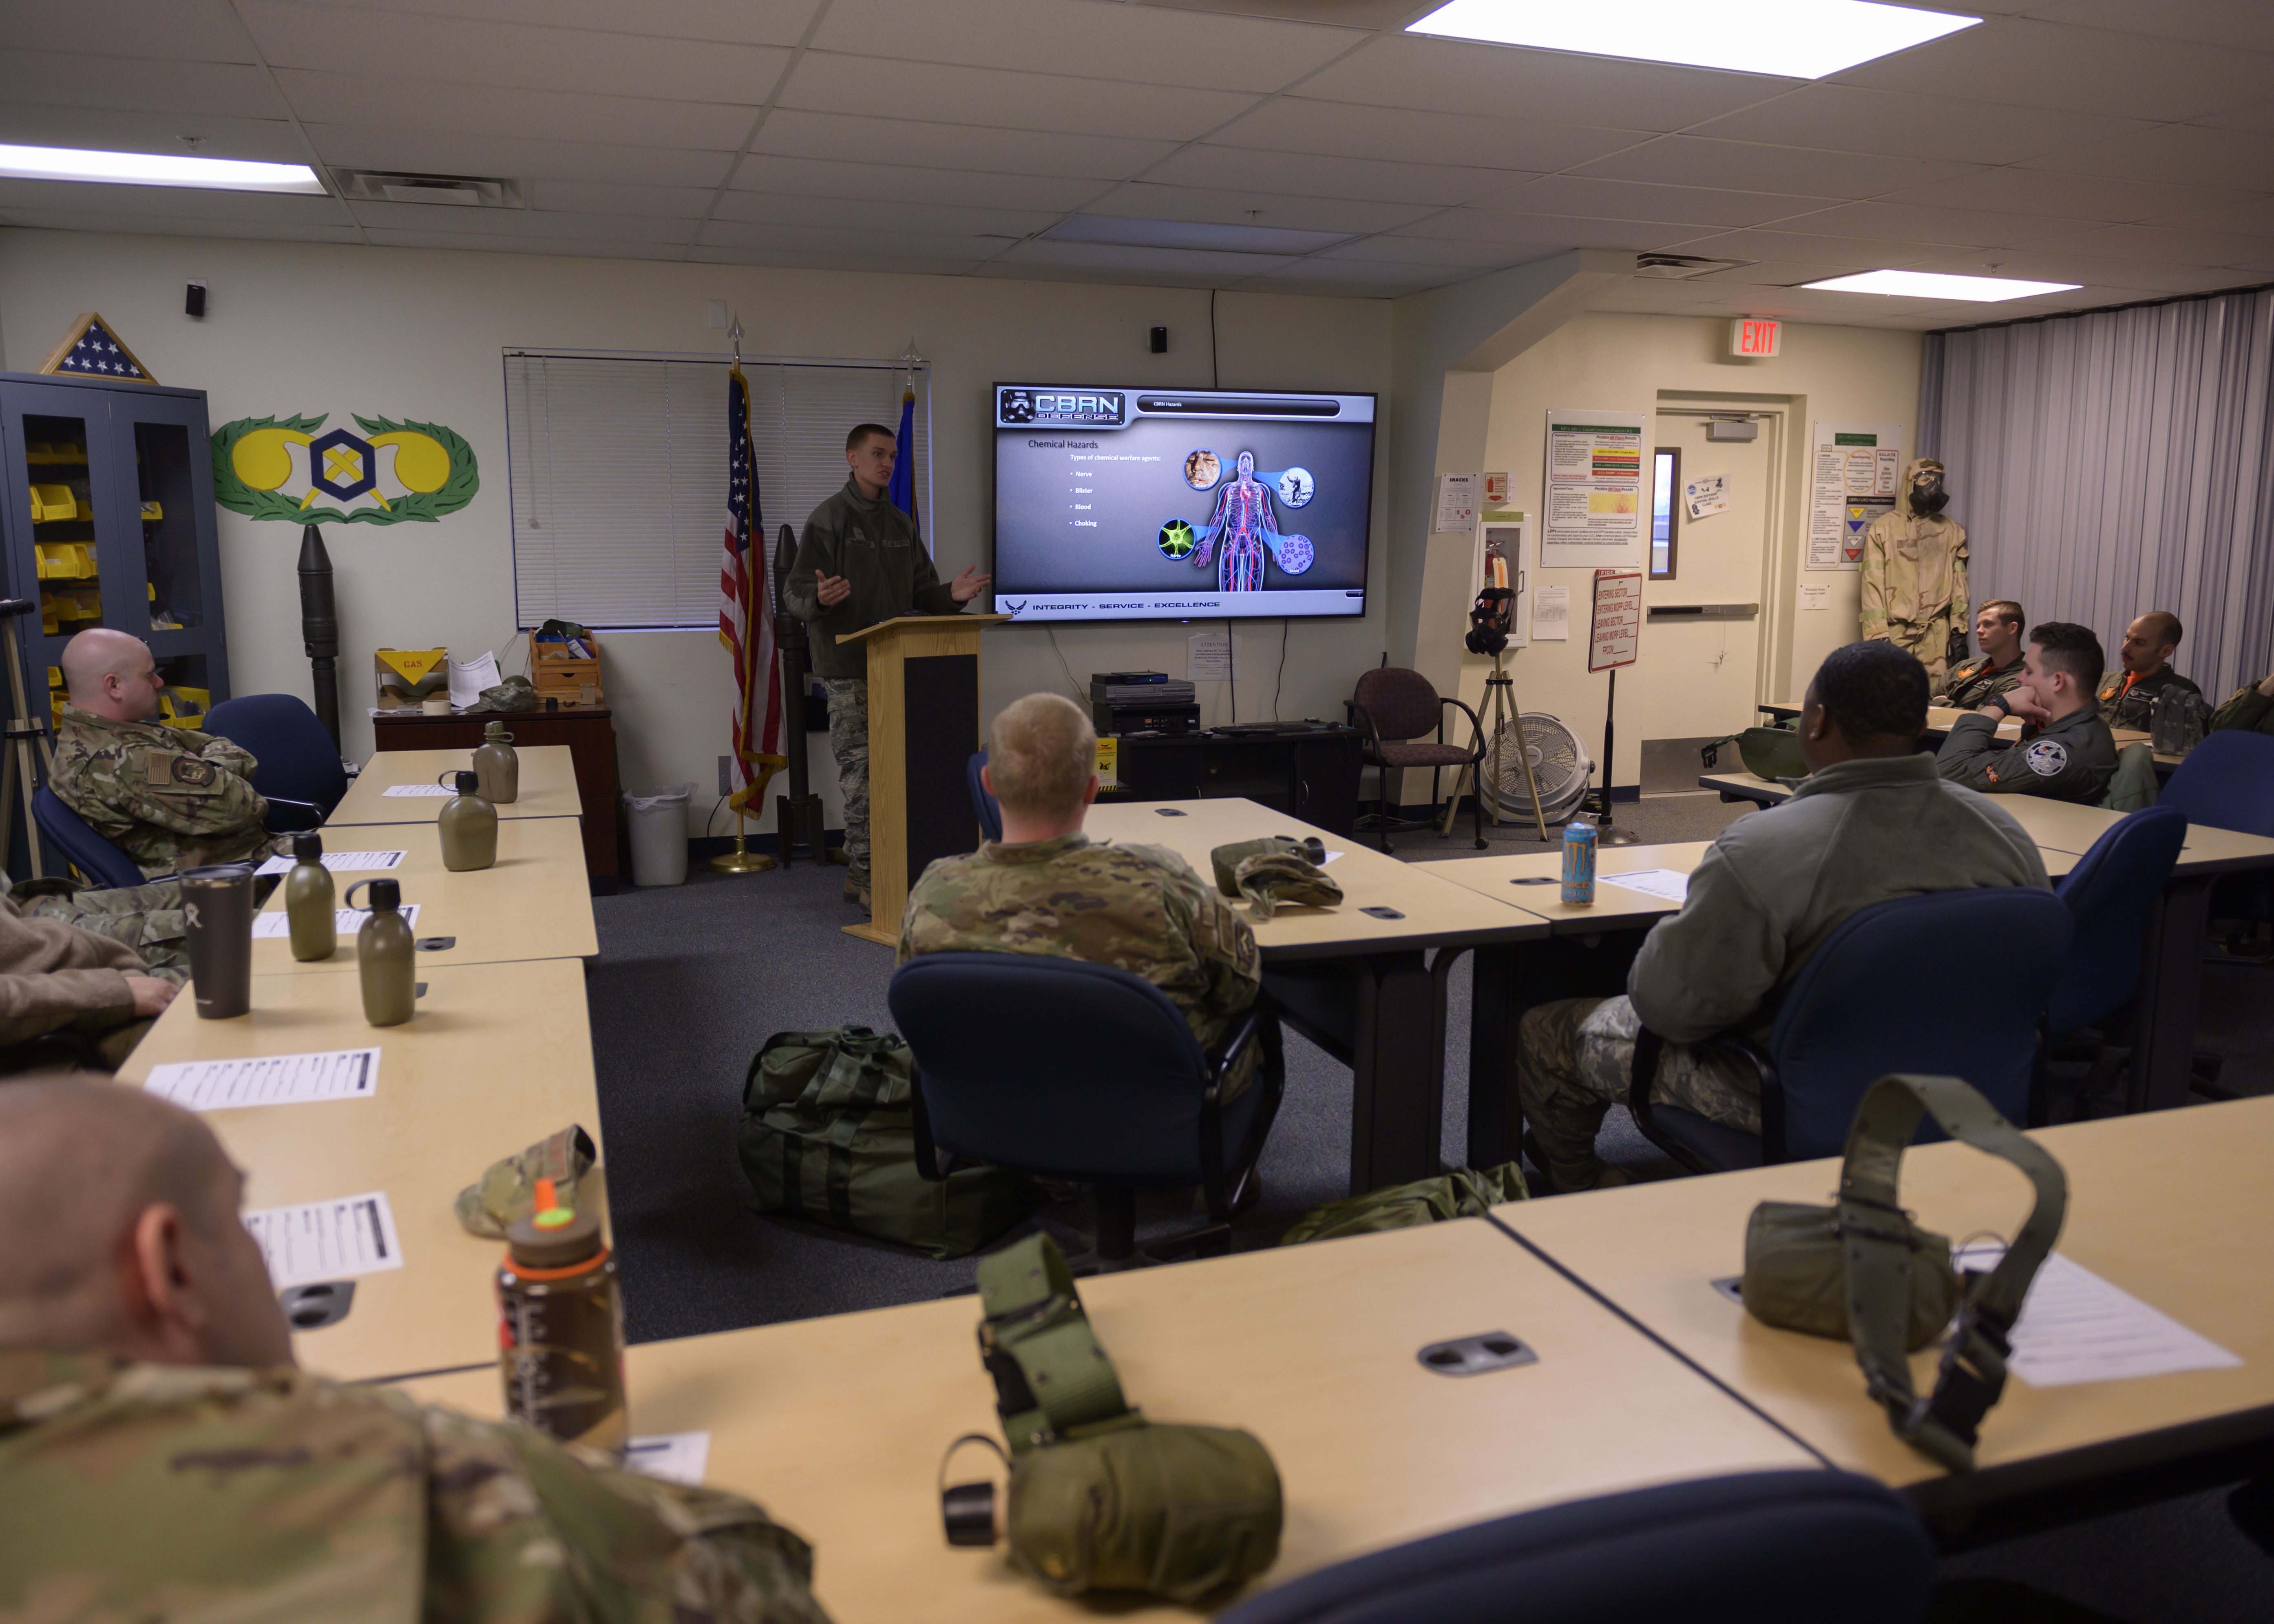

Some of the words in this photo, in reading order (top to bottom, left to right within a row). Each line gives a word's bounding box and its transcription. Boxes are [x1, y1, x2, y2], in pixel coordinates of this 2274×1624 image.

[1741, 321, 1777, 353] EXIT
[1035, 395, 1118, 413] CBRN
[1028, 439, 1065, 448] Chemical
[1067, 440, 1098, 449] Hazards
[1598, 589, 1614, 600] ENTERING
[1597, 603, 1613, 614] ENTERING
[1614, 602, 1623, 612] MOPP
[1596, 618, 1610, 629] LEAVING
[1595, 632, 1609, 643] LEAVING
[1609, 630, 1618, 640] MOPP
